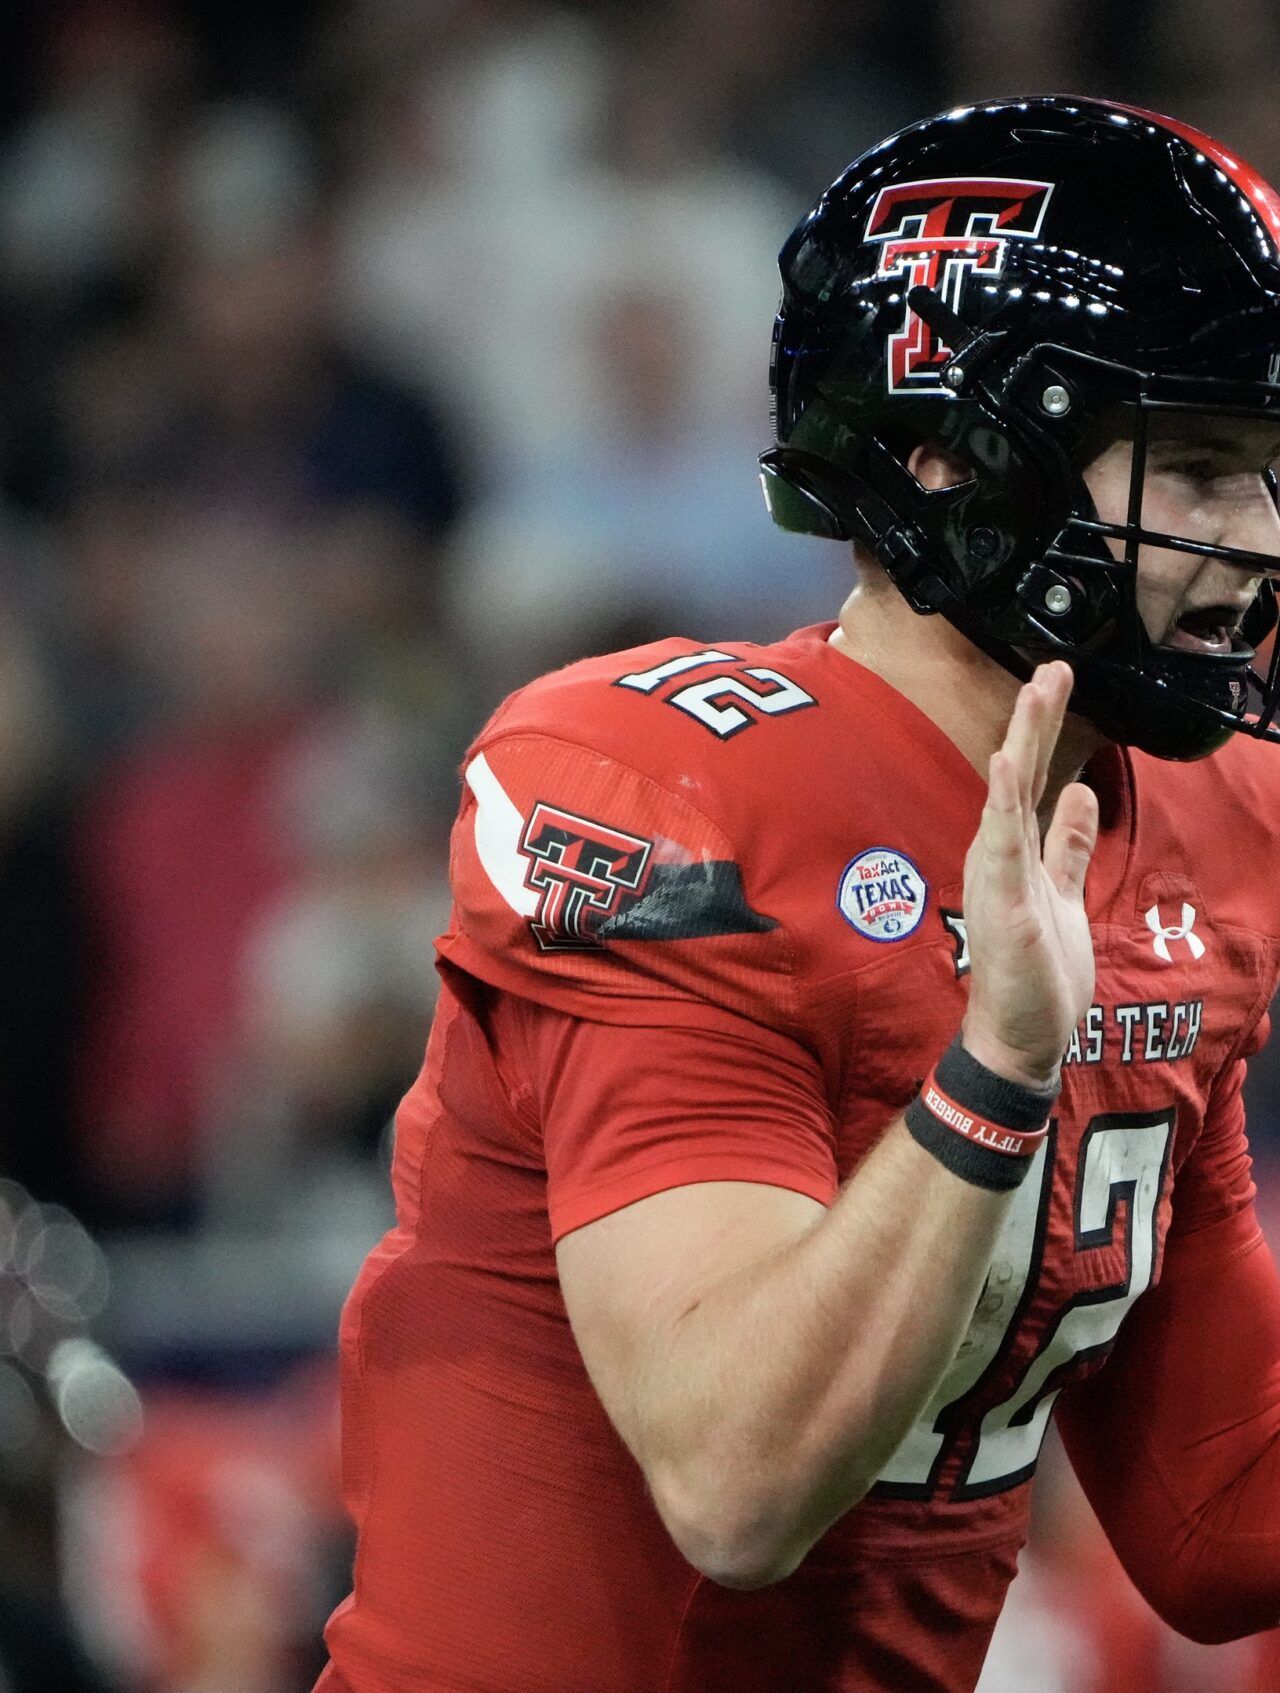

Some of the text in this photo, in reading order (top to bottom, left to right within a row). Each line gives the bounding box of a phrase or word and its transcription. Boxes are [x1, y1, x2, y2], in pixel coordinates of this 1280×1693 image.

[611, 649, 818, 741] 12
[852, 874, 915, 914] TEXAS
[857, 860, 900, 880] TaxAct
[1115, 1001, 1203, 1063] TECH
[925, 1087, 1024, 1153] FIFTY BURGER
